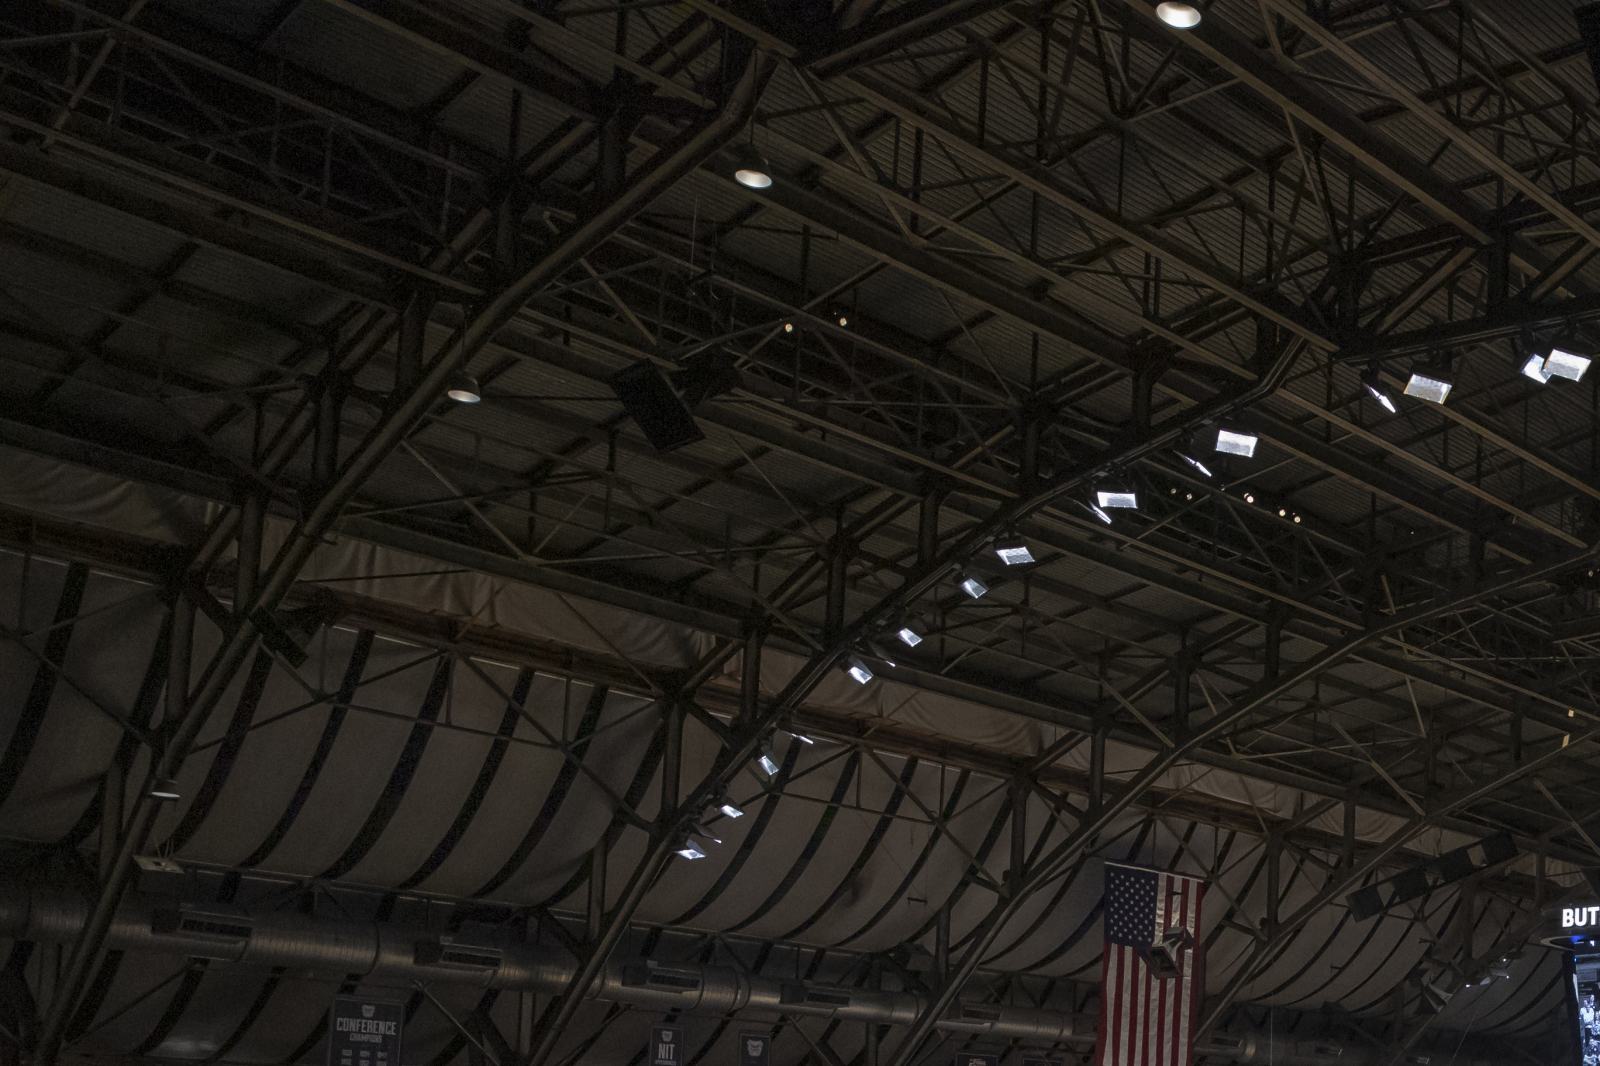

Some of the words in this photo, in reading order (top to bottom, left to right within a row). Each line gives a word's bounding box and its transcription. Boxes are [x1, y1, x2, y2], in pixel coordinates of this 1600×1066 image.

[336, 1018, 397, 1035] CONFERENCE
[350, 1033, 382, 1043] CHAMPIONS
[658, 1043, 675, 1060] NIT
